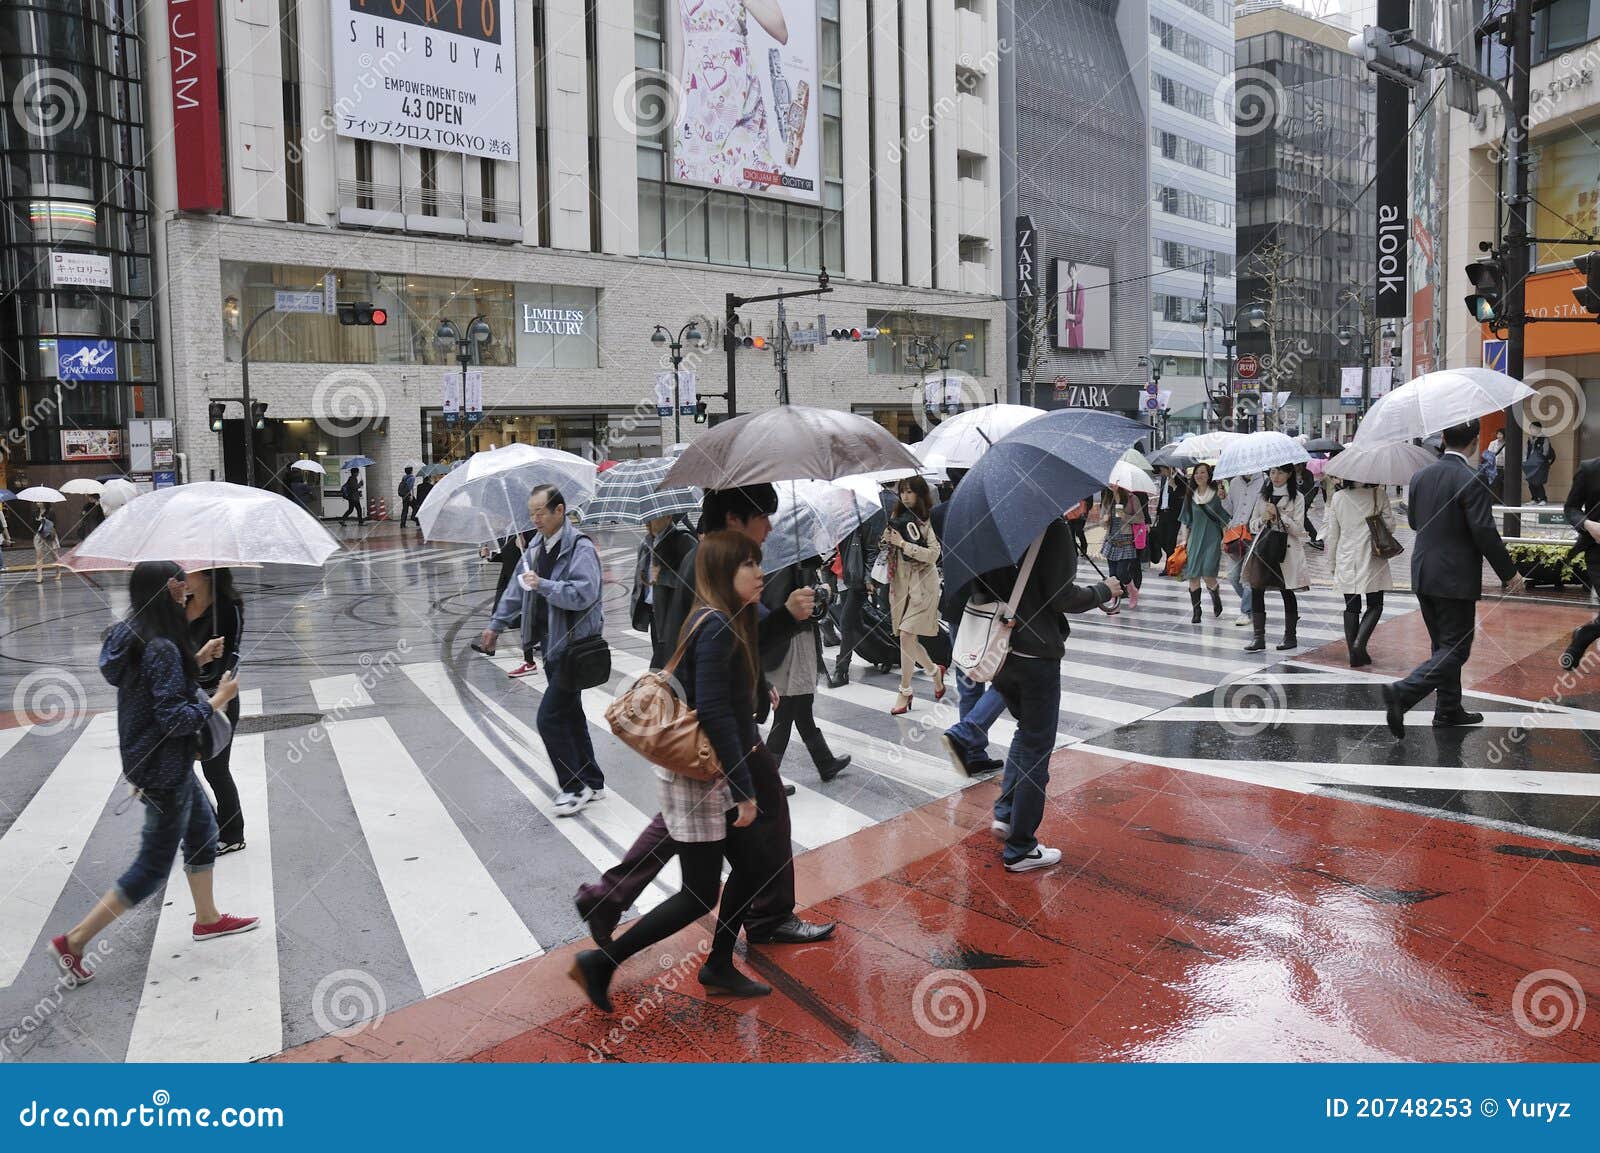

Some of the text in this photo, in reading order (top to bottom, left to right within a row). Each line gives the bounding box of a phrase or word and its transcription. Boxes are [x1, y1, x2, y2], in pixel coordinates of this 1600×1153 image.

[172, 13, 200, 110] JAM
[350, 20, 502, 74] SHIBUYA
[384, 77, 477, 106] EMPOWERMENT GYM
[401, 96, 463, 126] 4.3 OPEN
[434, 128, 485, 151] TOKYO
[488, 138, 512, 156] 渋谷
[1017, 229, 1034, 298] ZARA
[1378, 204, 1405, 295] alook
[523, 303, 584, 321] LIMITLESS
[523, 318, 584, 335] LUXURY
[90, 366, 115, 375] CROSS
[1069, 385, 1110, 407] ZARA
